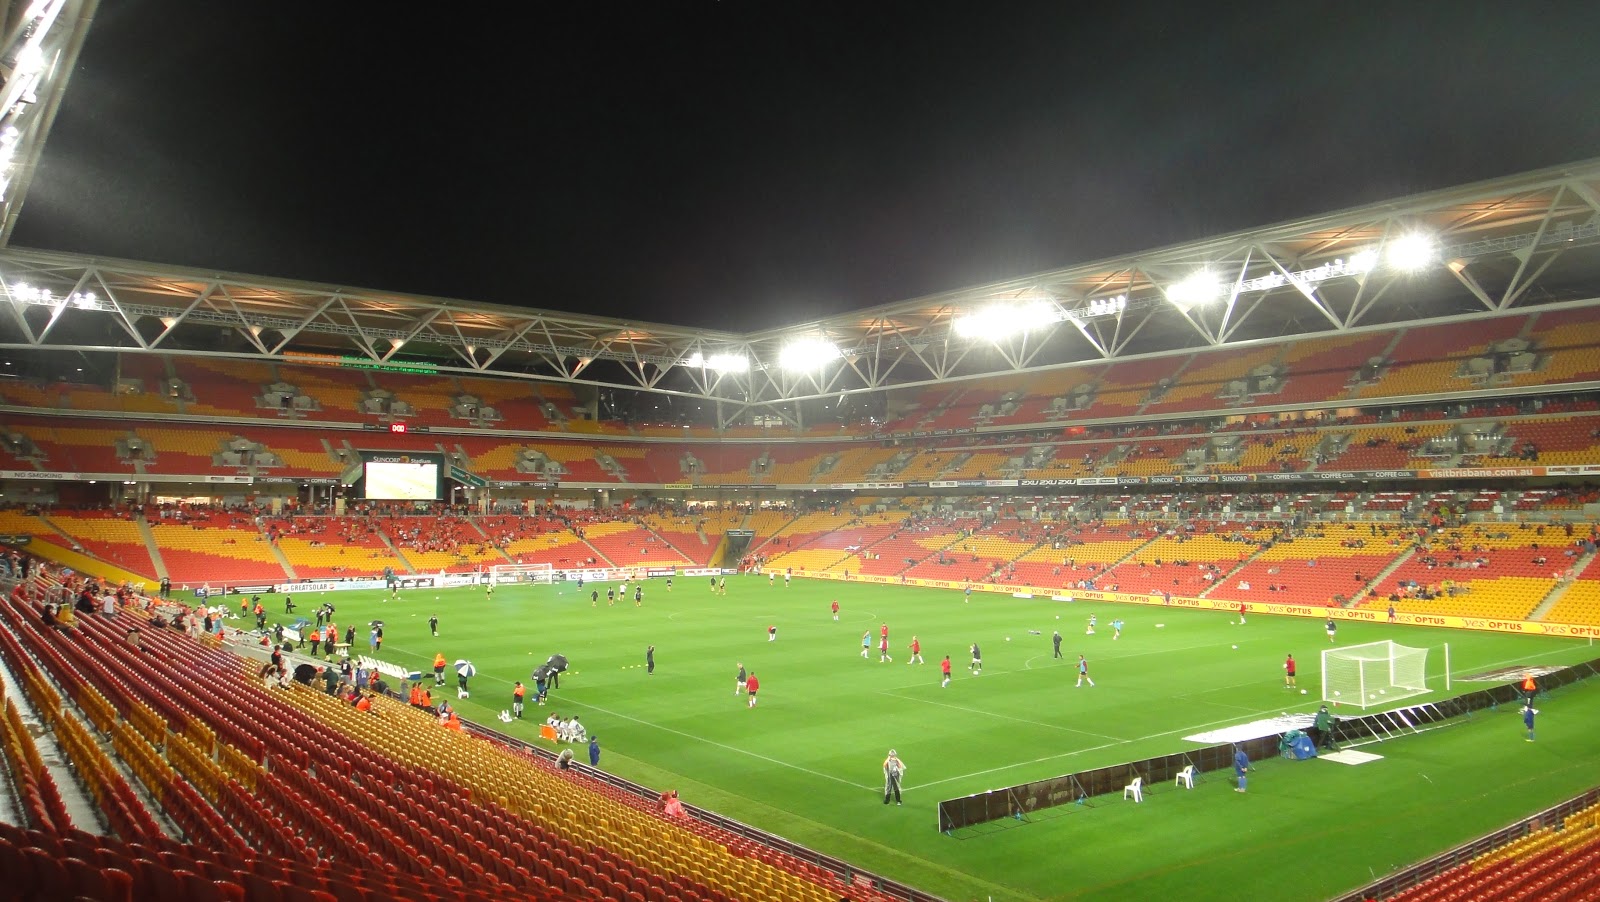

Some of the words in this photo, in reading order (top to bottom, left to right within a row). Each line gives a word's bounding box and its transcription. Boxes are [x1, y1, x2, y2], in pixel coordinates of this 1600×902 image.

[1430, 468, 1533, 478] visitbrisbane.com.au
[1347, 611, 1375, 619] OPTUS
[1415, 616, 1445, 625] OPTUS
[1488, 621, 1522, 630] OPTUS
